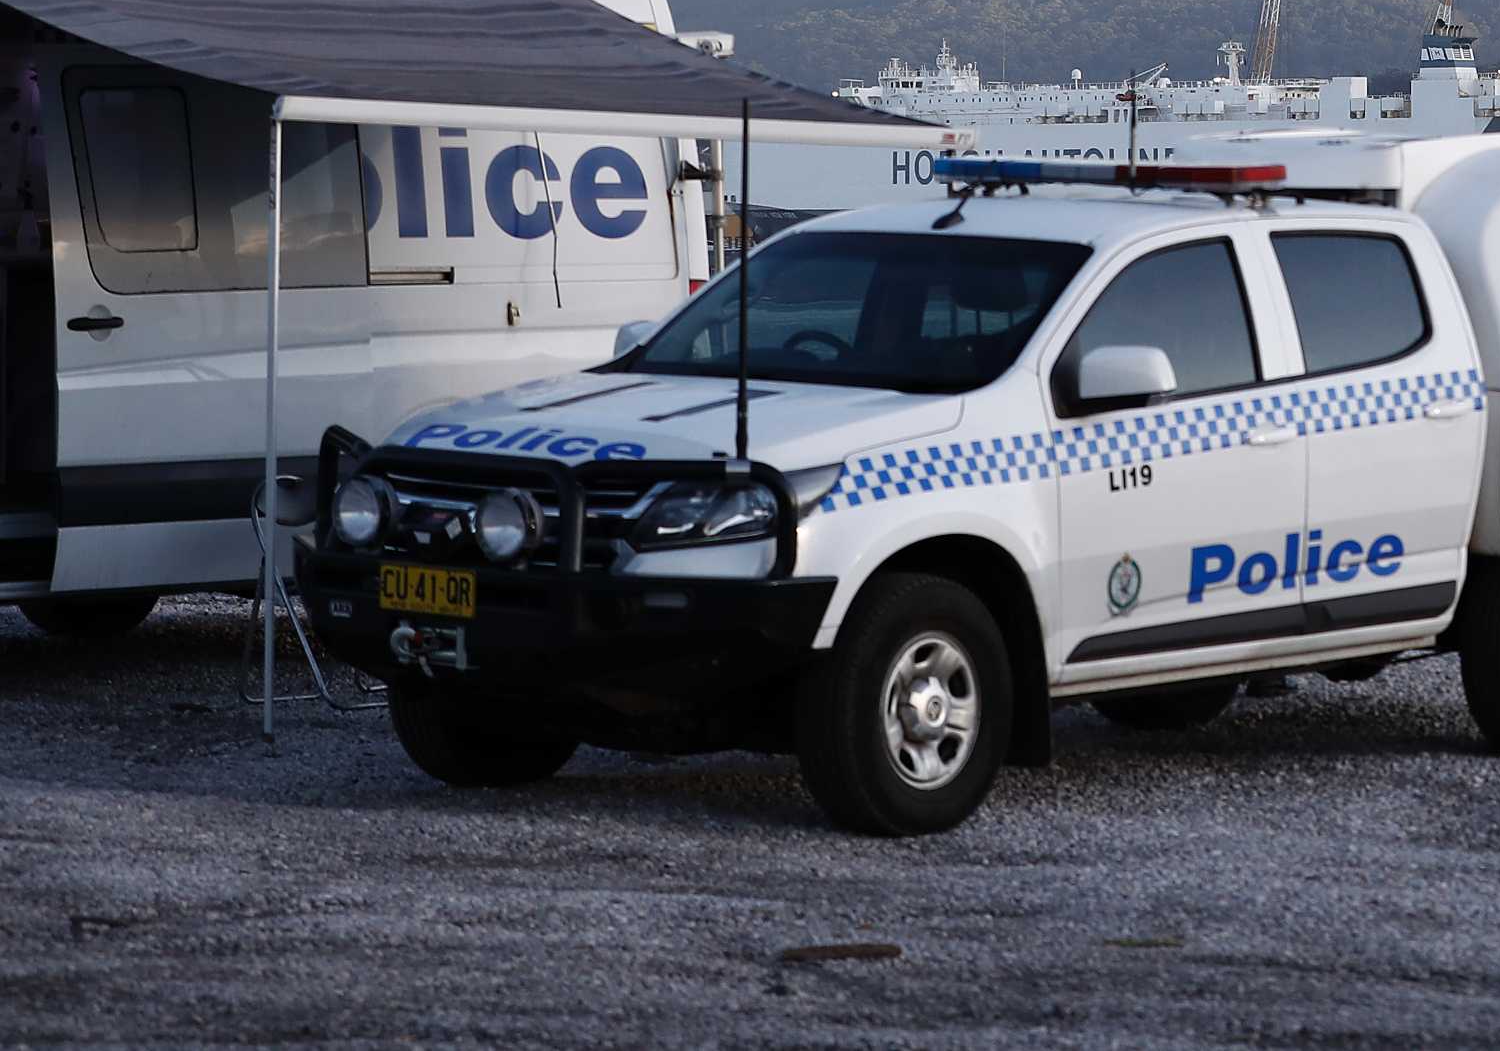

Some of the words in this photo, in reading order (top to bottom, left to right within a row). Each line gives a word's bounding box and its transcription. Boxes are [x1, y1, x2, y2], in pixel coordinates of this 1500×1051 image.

[364, 125, 648, 240] lice
[403, 423, 648, 462] Police
[1109, 464, 1152, 492] LI19
[1187, 529, 1405, 605] Police
